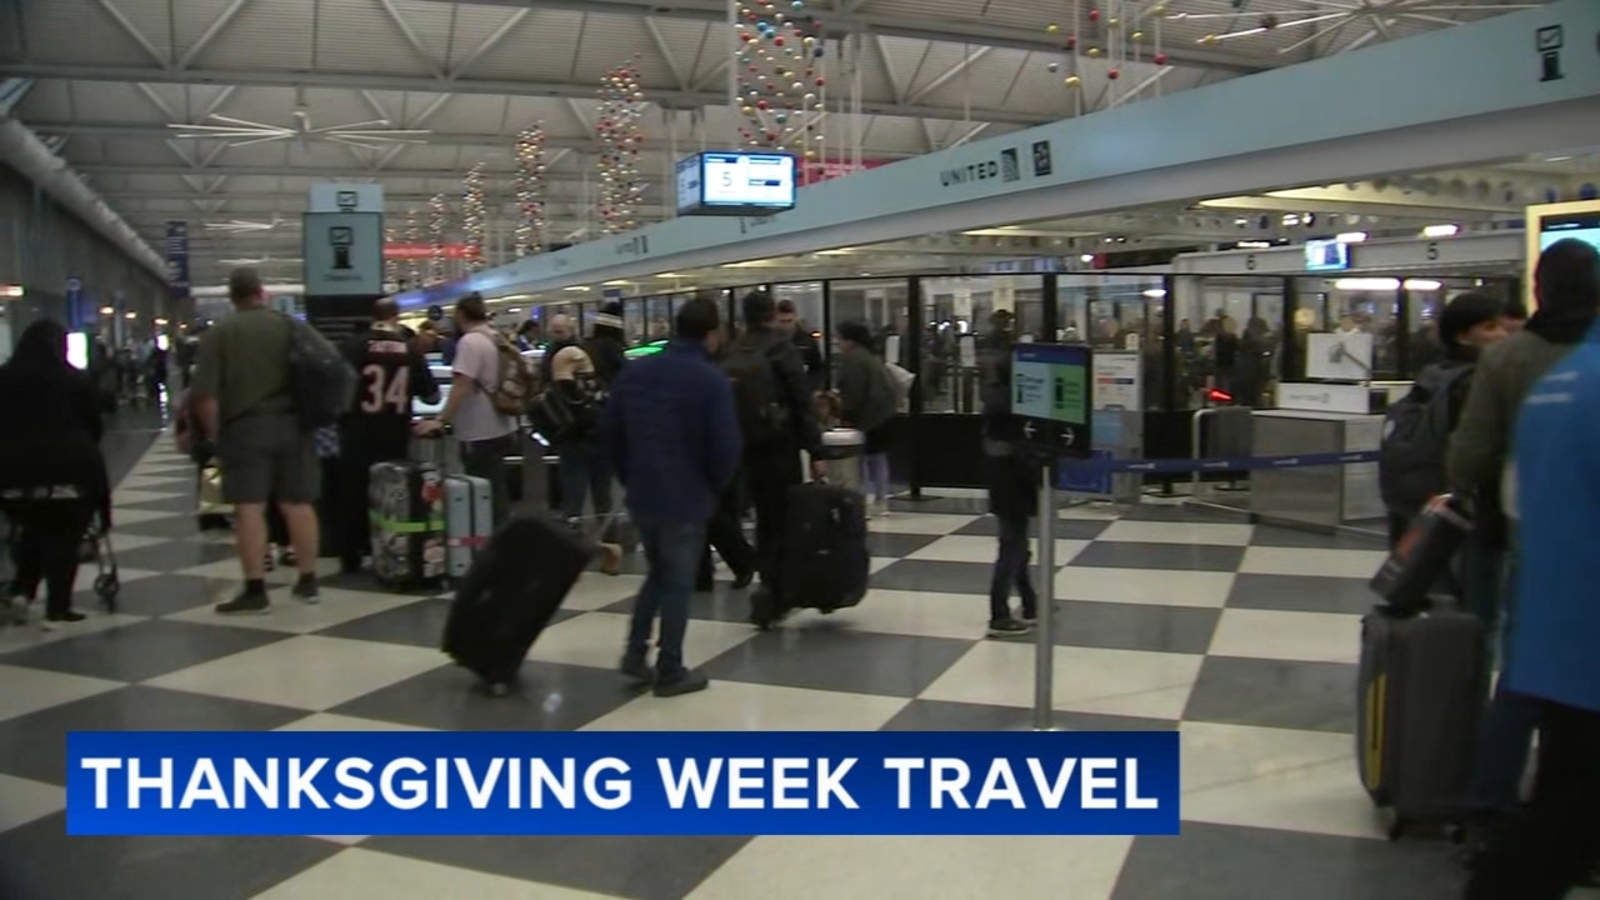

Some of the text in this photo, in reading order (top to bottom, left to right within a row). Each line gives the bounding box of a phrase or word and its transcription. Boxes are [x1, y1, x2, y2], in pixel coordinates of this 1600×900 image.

[722, 171, 732, 187] 5
[940, 160, 998, 187] UNITED
[1426, 242, 1439, 260] 5
[1245, 254, 1256, 270] 6
[361, 364, 410, 414] 34
